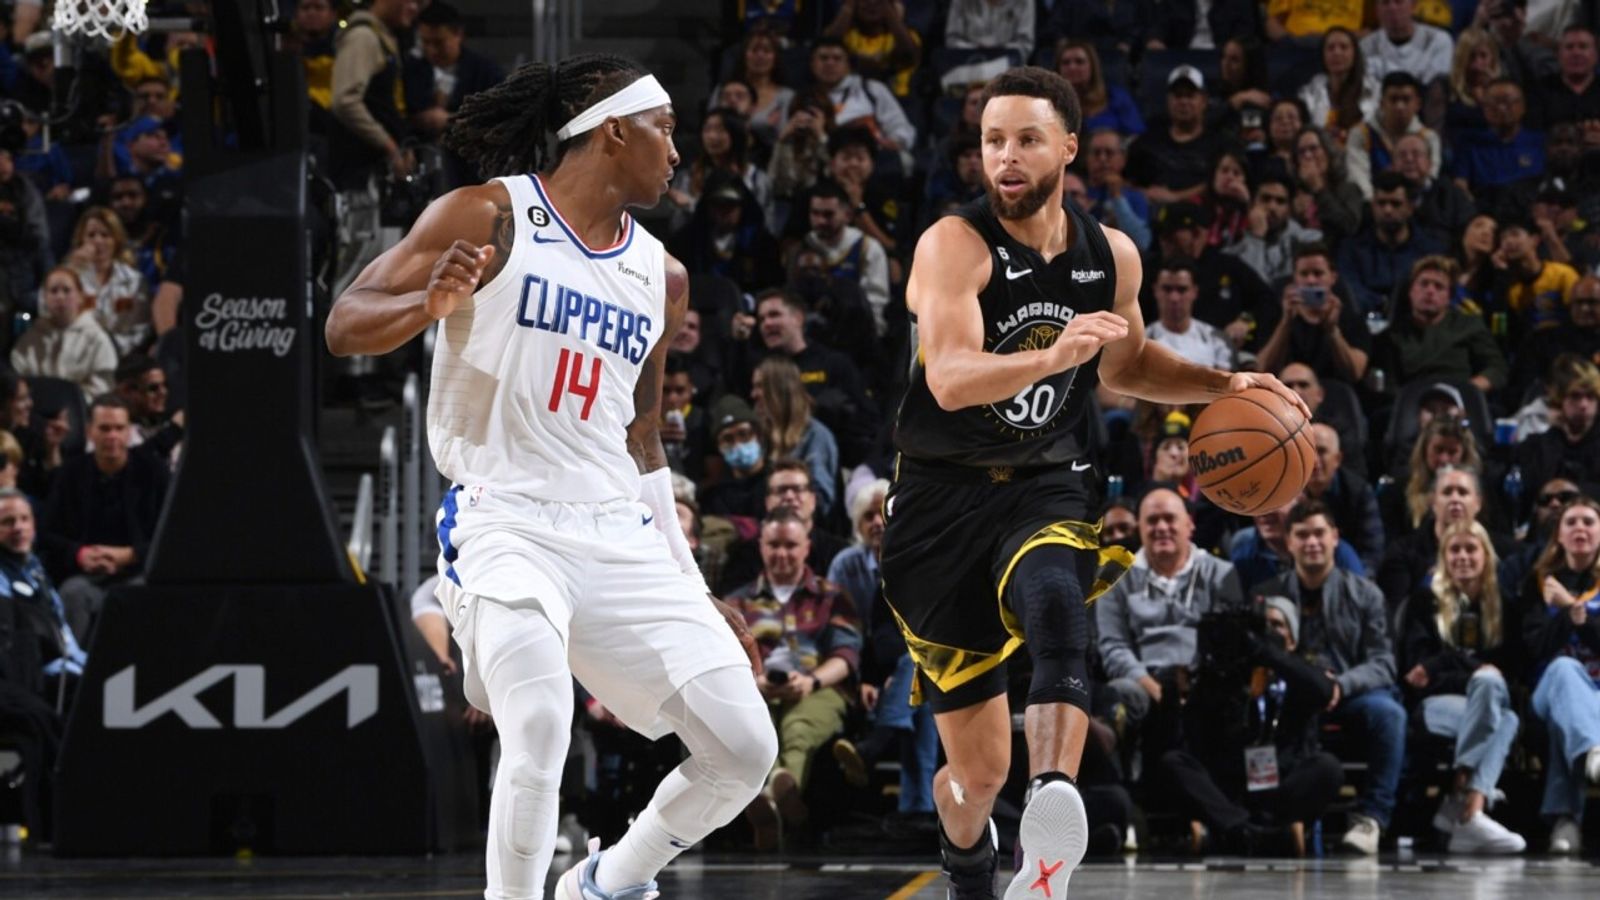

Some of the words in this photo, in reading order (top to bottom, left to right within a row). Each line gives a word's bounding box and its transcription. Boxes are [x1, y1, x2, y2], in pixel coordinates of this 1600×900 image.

[532, 209, 546, 225] 6
[1071, 269, 1105, 281] Rakuten
[195, 292, 287, 329] Season
[516, 273, 651, 366] CLIPPERS
[996, 302, 1074, 334] WARRIO
[199, 328, 217, 351] of
[219, 320, 297, 357] Giving
[548, 348, 602, 421] 14
[1005, 384, 1055, 424] 30
[103, 664, 379, 728] KIA
